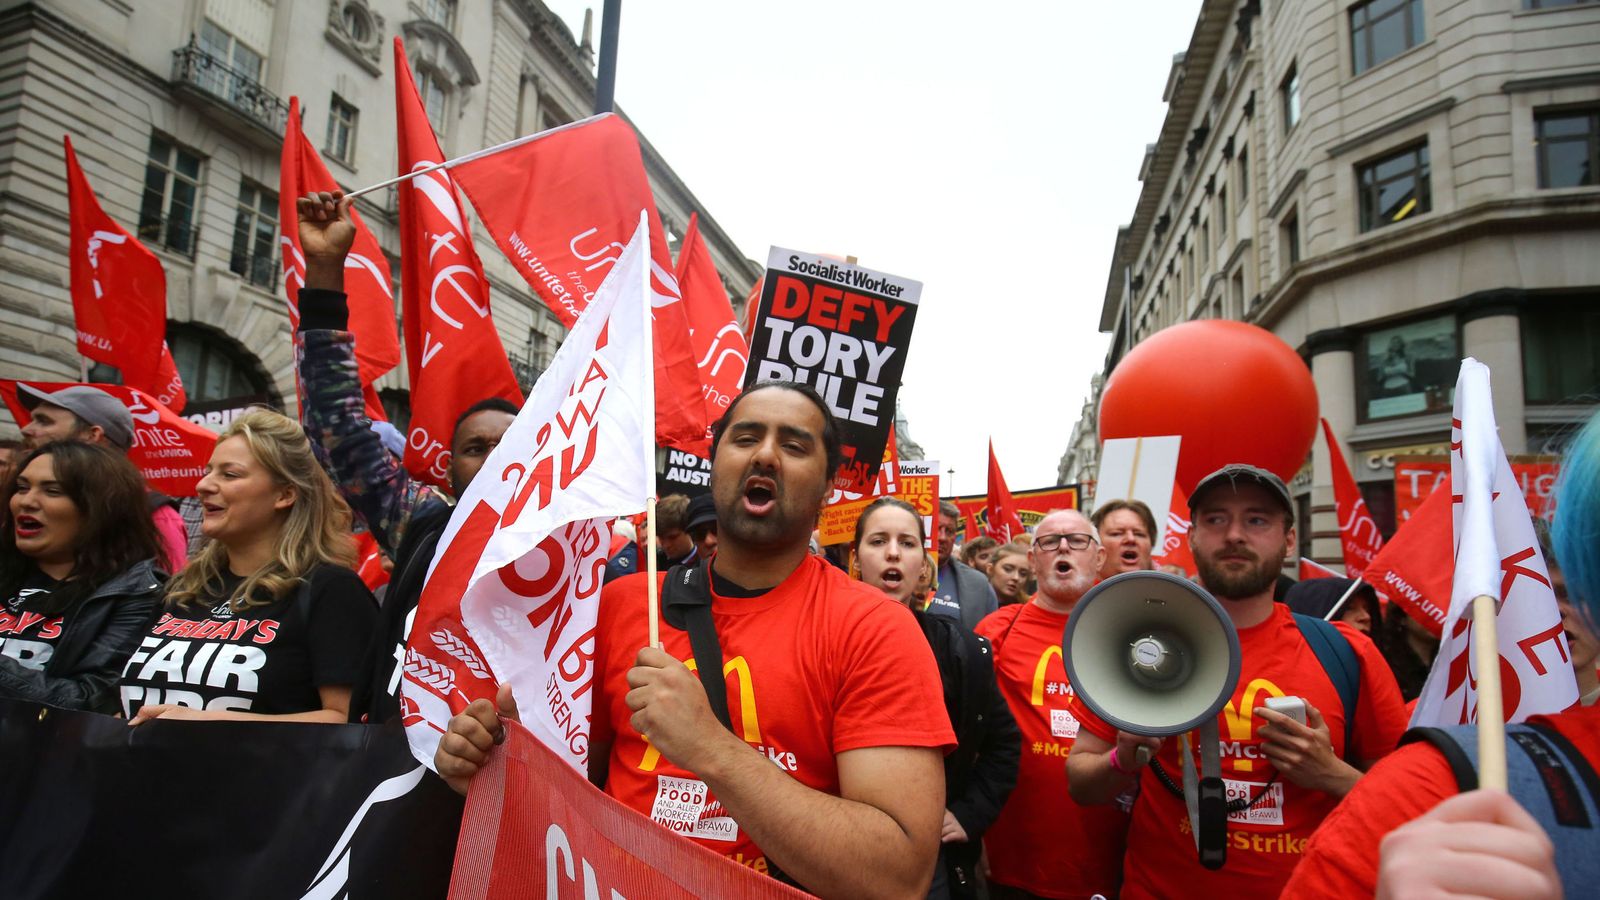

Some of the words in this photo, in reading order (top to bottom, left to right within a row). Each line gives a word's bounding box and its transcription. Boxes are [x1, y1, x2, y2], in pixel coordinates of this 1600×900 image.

[788, 255, 852, 284] Socialist
[852, 272, 904, 298] Worker
[770, 275, 906, 343] DEFY
[764, 317, 896, 384] TORY
[669, 450, 698, 468] NO
[665, 467, 712, 487] AUST
[900, 477, 933, 494] THE
[120, 636, 267, 694] FAIR
[661, 779, 705, 794] BAKERS
[657, 799, 675, 809] AND
[660, 788, 702, 805] FOOD
[656, 806, 697, 822] WORKERS
[697, 819, 733, 833] BFAWU
